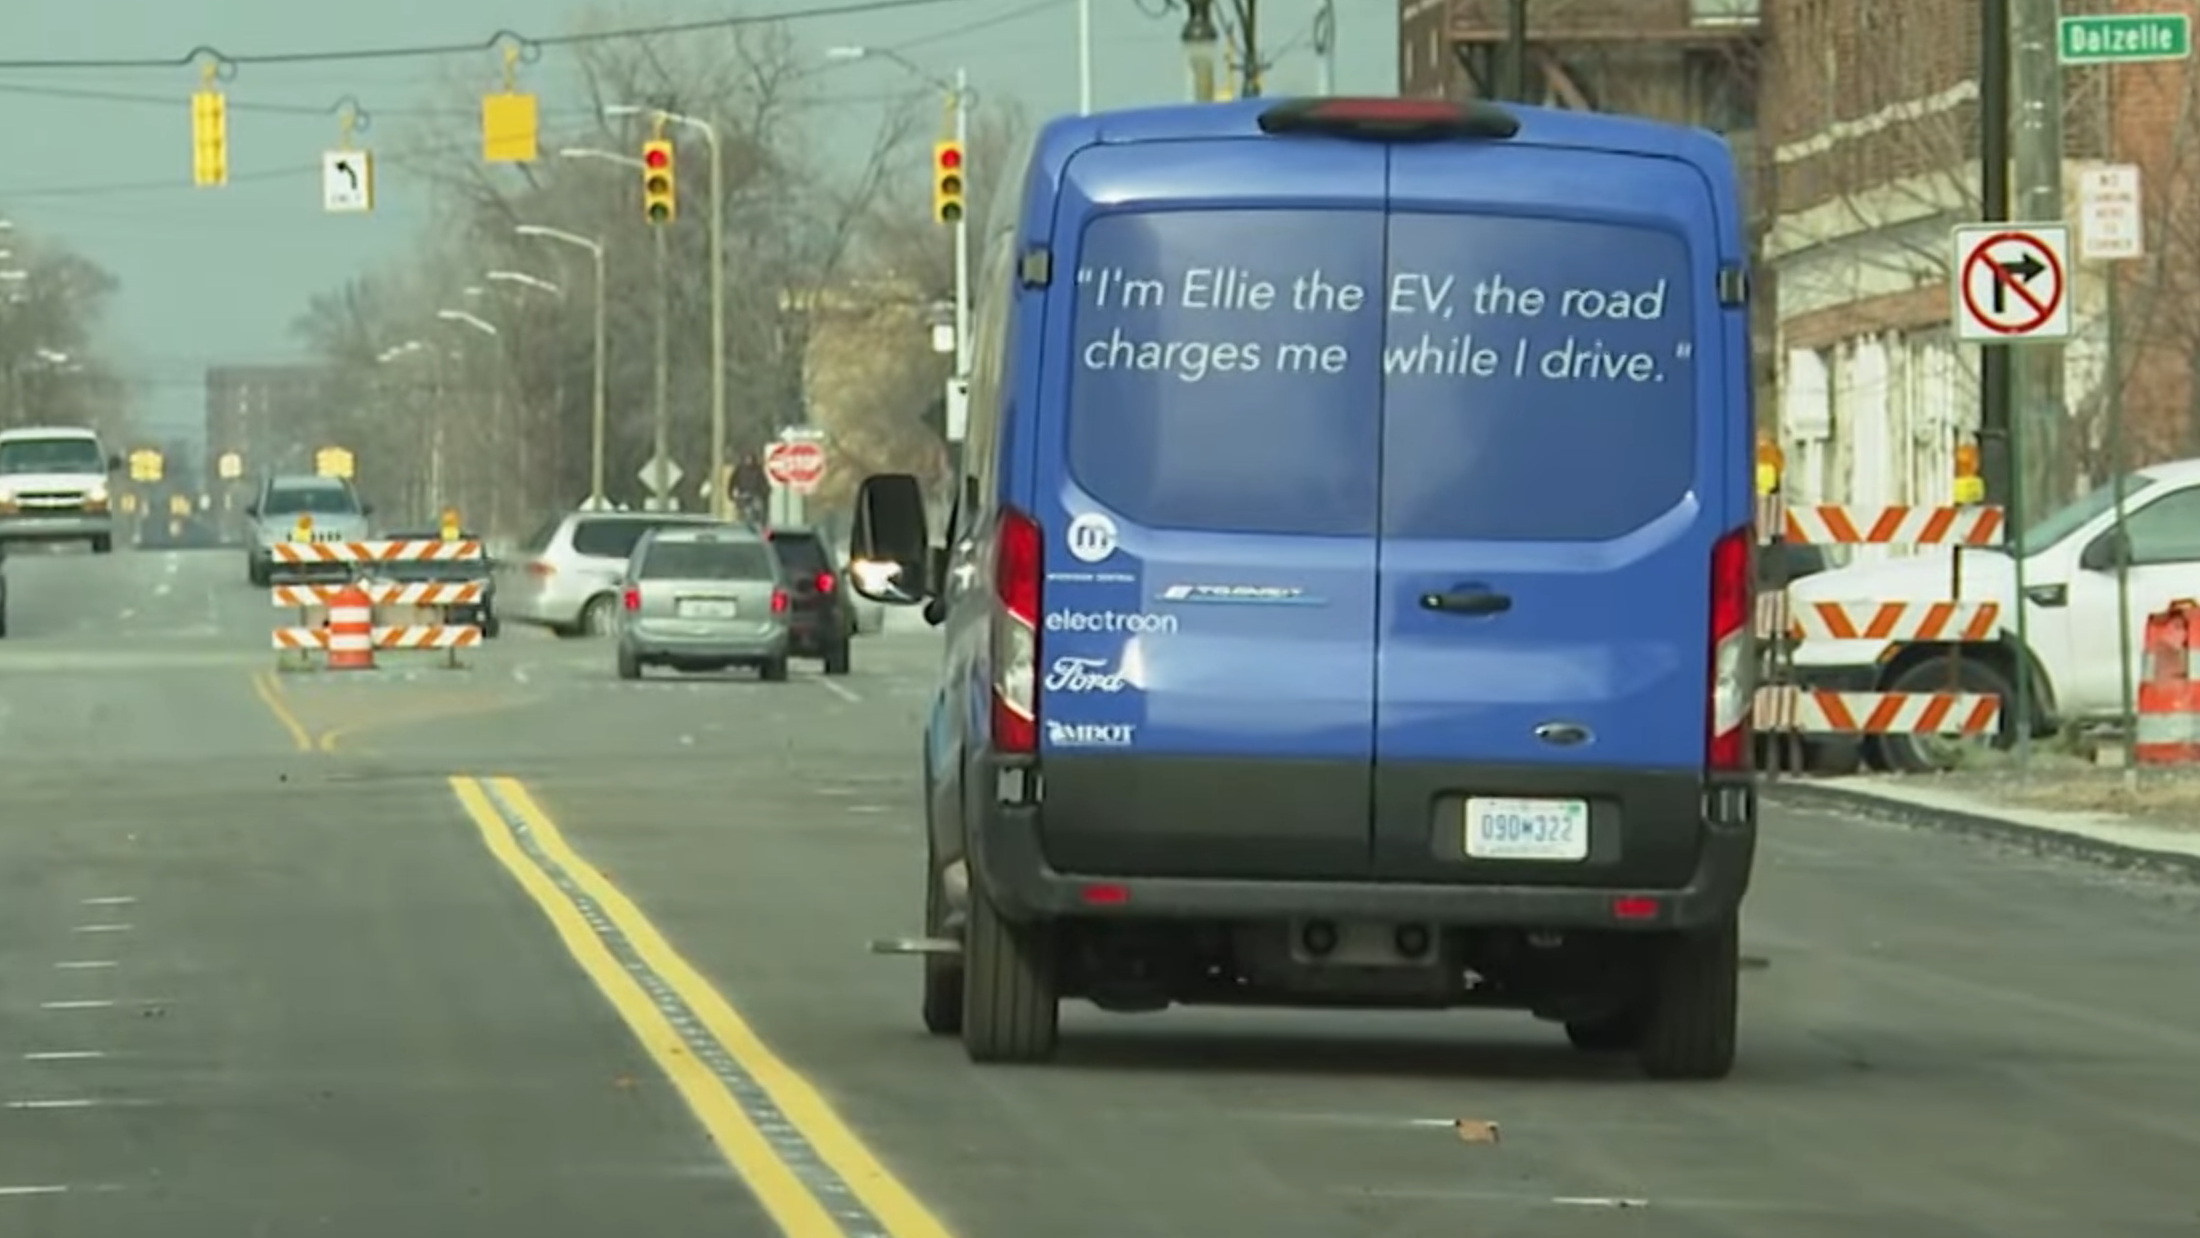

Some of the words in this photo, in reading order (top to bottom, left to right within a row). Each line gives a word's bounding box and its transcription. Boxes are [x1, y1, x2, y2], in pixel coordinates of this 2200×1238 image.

[2070, 23, 2173, 52] Dalzelle
[1077, 266, 1164, 308] "I'm
[1182, 266, 1276, 311] Ellie
[1293, 267, 1364, 312] the
[1390, 273, 1454, 319] EV,
[1472, 273, 1545, 315] the
[1560, 278, 1666, 320] road
[1083, 327, 1261, 382] charges
[1276, 343, 1348, 373] me
[1383, 331, 1498, 377] while
[1514, 337, 1526, 377] I
[1045, 656, 1126, 692] Ford
